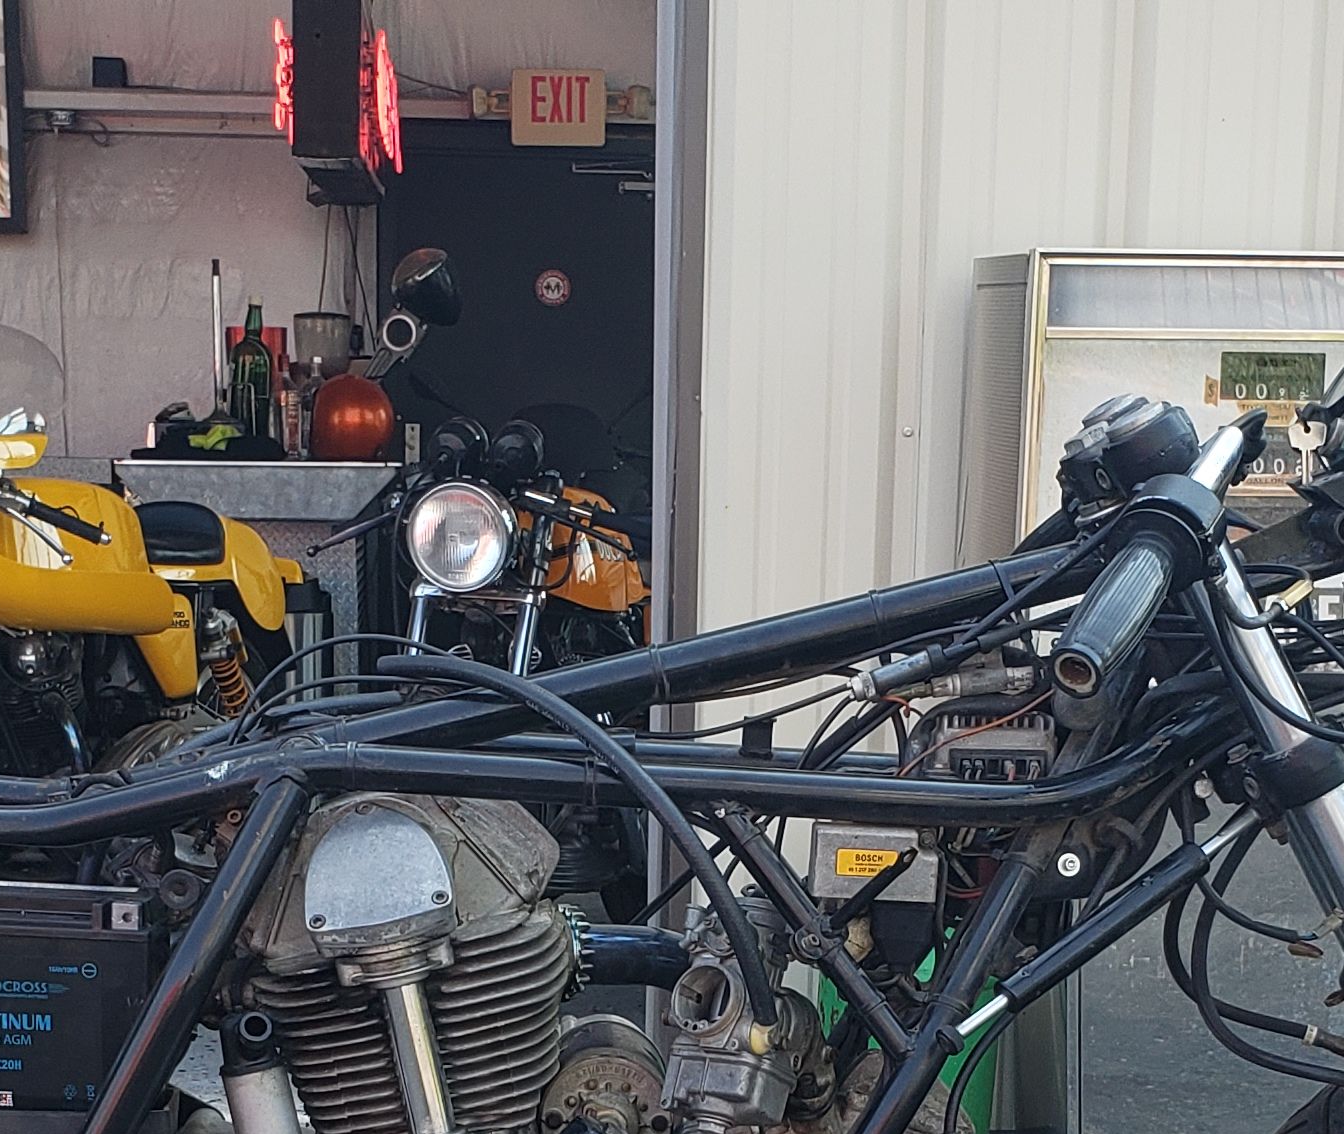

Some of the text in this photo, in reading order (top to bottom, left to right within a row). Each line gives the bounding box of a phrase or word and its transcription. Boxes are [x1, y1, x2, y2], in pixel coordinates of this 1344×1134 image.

[531, 76, 590, 123] EXIT
[855, 853, 884, 862] BOSCH
[5, 1033, 32, 1046] AGM
